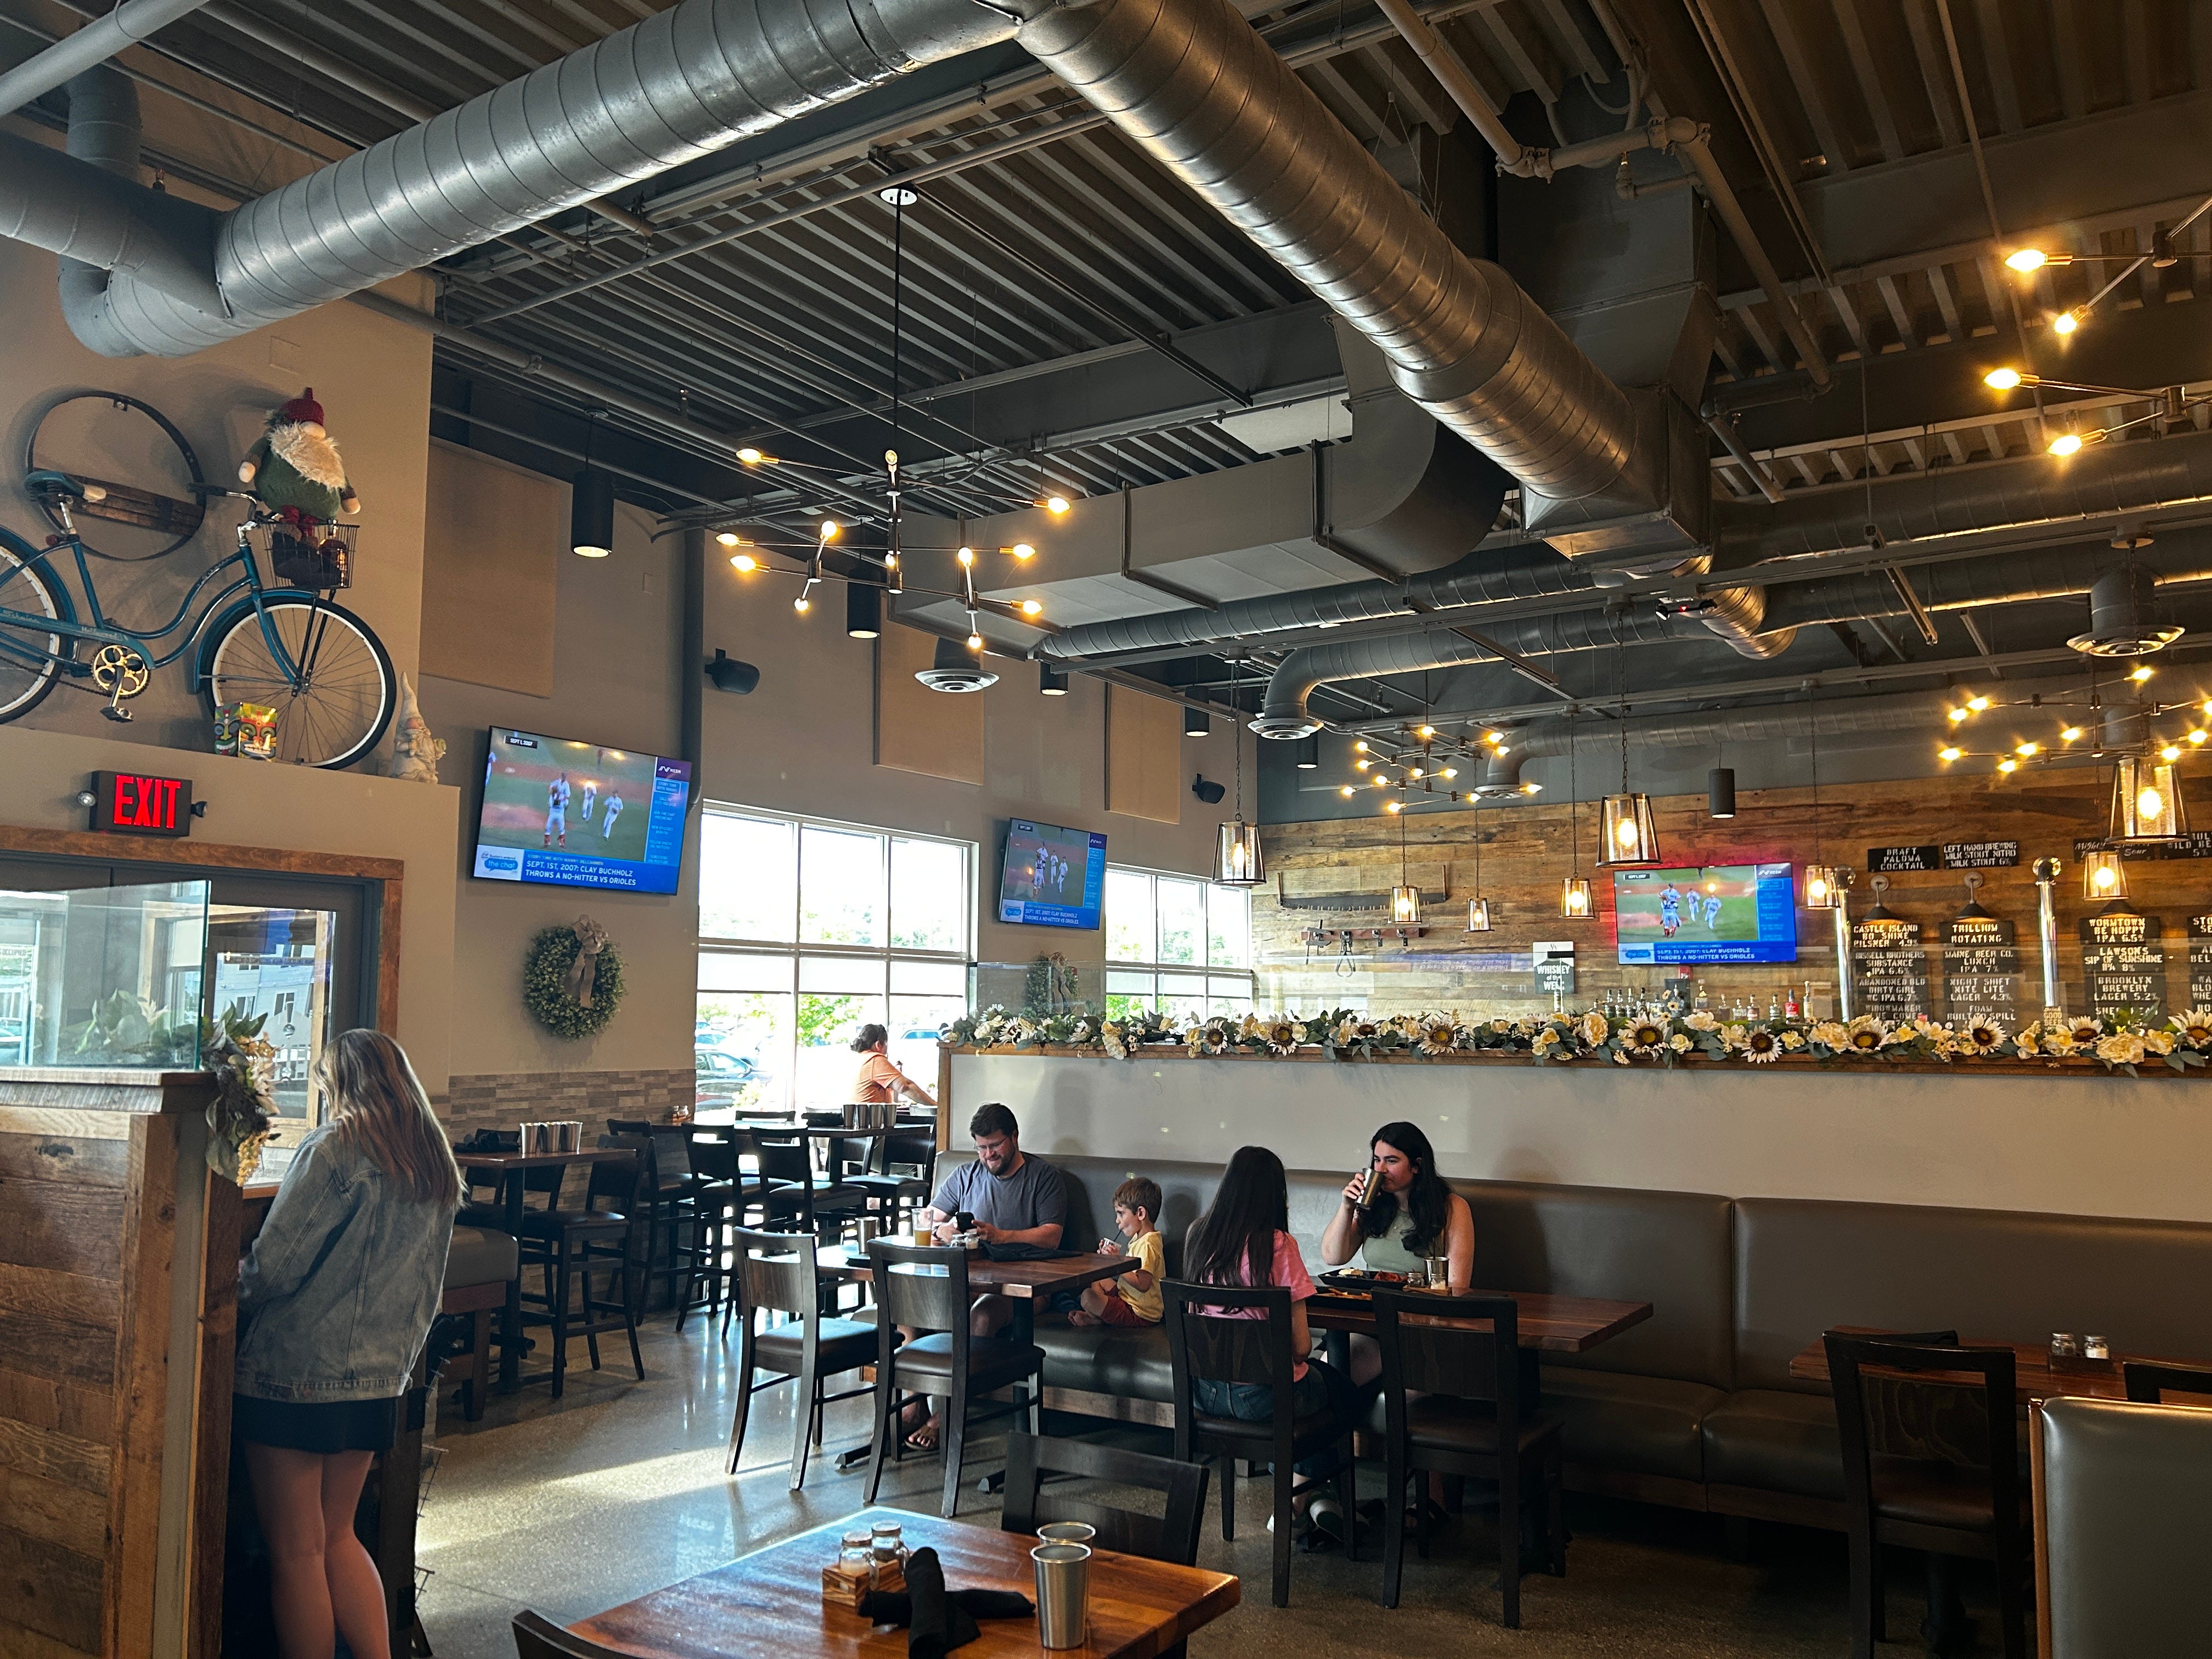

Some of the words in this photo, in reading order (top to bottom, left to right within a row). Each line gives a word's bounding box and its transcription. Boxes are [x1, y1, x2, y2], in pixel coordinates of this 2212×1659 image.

[114, 774, 181, 829] EXIT
[1887, 847, 1917, 855] DRAFT
[1944, 845, 1961, 853] LEFT
[1963, 844, 1984, 852] HAND
[1985, 842, 2017, 850] BREWING
[1883, 854, 1921, 864] PALOMA
[1945, 852, 1962, 860] MILK
[1965, 850, 1989, 859] STOUT
[1993, 849, 2016, 857] NITRO
[1880, 861, 1925, 871] COCKTAIL
[1971, 857, 1995, 867] STOUT
[527, 860, 545, 869] SEPT.
[547, 863, 558, 871] 1ST,
[560, 864, 579, 872] 2007:
[580, 866, 597, 874] CLAY
[599, 867, 633, 877] BUCHHOLZ
[525, 869, 554, 879] THROWS
[562, 873, 598, 883] NO-HITTER
[609, 877, 636, 886] ORIOLES
[2089, 918, 2145, 927] WORMTOWN
[1854, 924, 1884, 933] CASTLE
[1888, 924, 1918, 933] ISLAND
[1952, 924, 1997, 933] TRILLIUM
[2094, 927, 2107, 935] BE
[2111, 926, 2145, 934] HOPPY
[1881, 932, 1909, 940] SHINE
[1951, 934, 2002, 943] ROTATING
[2097, 934, 2115, 943] IPA
[1854, 939, 1890, 948] PILSNER
[1886, 951, 1925, 959] BROTHERS
[1944, 950, 1970, 958] MAINE
[1975, 949, 1996, 958] BEER
[2000, 950, 2013, 958] CO.
[1866, 959, 1914, 967] SUBSTANCE
[1964, 957, 1995, 966] LUNCH
[2085, 956, 2100, 965] SIP
[2119, 954, 2163, 963] SUNSHINE
[1537, 965, 1570, 974] WHISKEY
[1888, 967, 1910, 975] 6.6%
[1985, 965, 1999, 973] 7%
[2121, 963, 2136, 972] 8%
[1859, 978, 1907, 986] ABANDONED
[1950, 978, 1978, 986] NIGHT
[1984, 978, 2011, 986] SHIFT
[2098, 976, 2152, 985] BROOKLYN
[1869, 986, 1894, 994] DIRTY
[1896, 986, 1916, 994] GIRL
[1954, 985, 1977, 994] NITE
[1983, 985, 2005, 994] LITE
[2102, 984, 2148, 992] BREWERY
[1881, 994, 1895, 1002] IPA
[1990, 993, 2012, 1001] 4.3%
[2094, 992, 2127, 1001] LAGER
[1865, 1003, 1921, 1012] WIDOWMAKER
[1947, 1012, 1973, 1020] BUILT
[1989, 1012, 2016, 1020] SPILL
